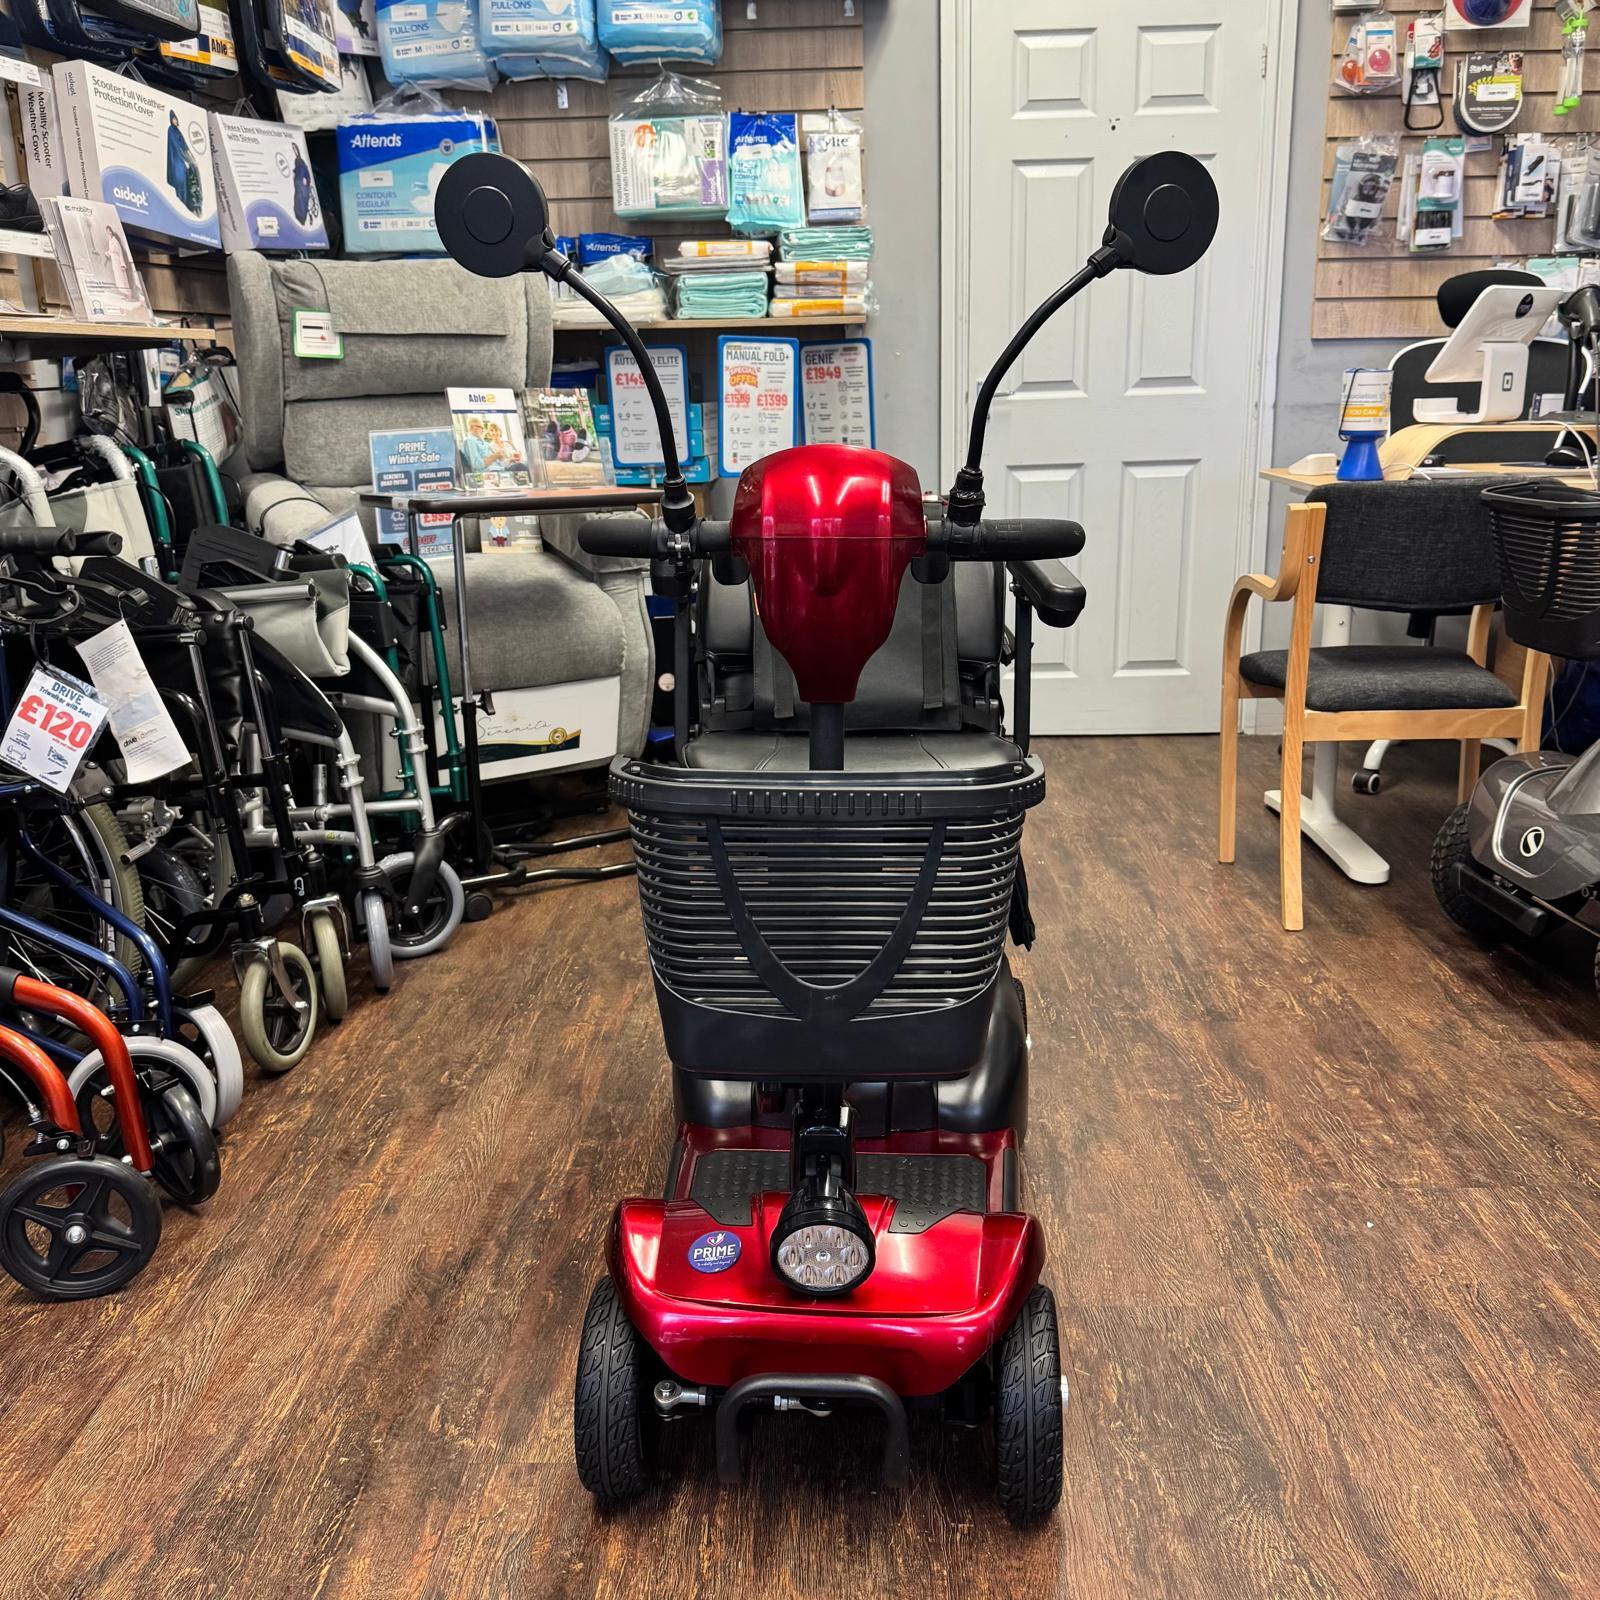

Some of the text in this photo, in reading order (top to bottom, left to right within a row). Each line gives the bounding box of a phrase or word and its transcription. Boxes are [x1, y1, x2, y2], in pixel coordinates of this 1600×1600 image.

[491, 1, 532, 10] PULL-ONS
[389, 23, 430, 36] PULL-ONS
[92, 75, 166, 111] Scooter Full Weather
[93, 87, 155, 118] Protection Cover
[27, 91, 37, 134] Weather
[32, 135, 41, 163] Cover
[37, 91, 51, 169] Mobility Scooter
[351, 133, 402, 148] Attends
[113, 186, 149, 207] aidapt
[356, 191, 397, 200] CONTOURS
[356, 200, 391, 208] REGULAR
[586, 243, 621, 252] Attends
[657, 356, 680, 365] ELITE
[726, 350, 762, 361] MANUAL
[805, 352, 835, 365] GENIE
[806, 366, 841, 380] £1949
[468, 393, 497, 403] Able2
[757, 394, 788, 407] £1399
[398, 441, 428, 453] PRIME
[388, 453, 441, 466] Winter Sale
[51, 682, 85, 704] DRIVE
[39, 686, 92, 718] Triwalker with Seat
[17, 694, 93, 749] £120
[693, 1244, 736, 1260] PRIME
